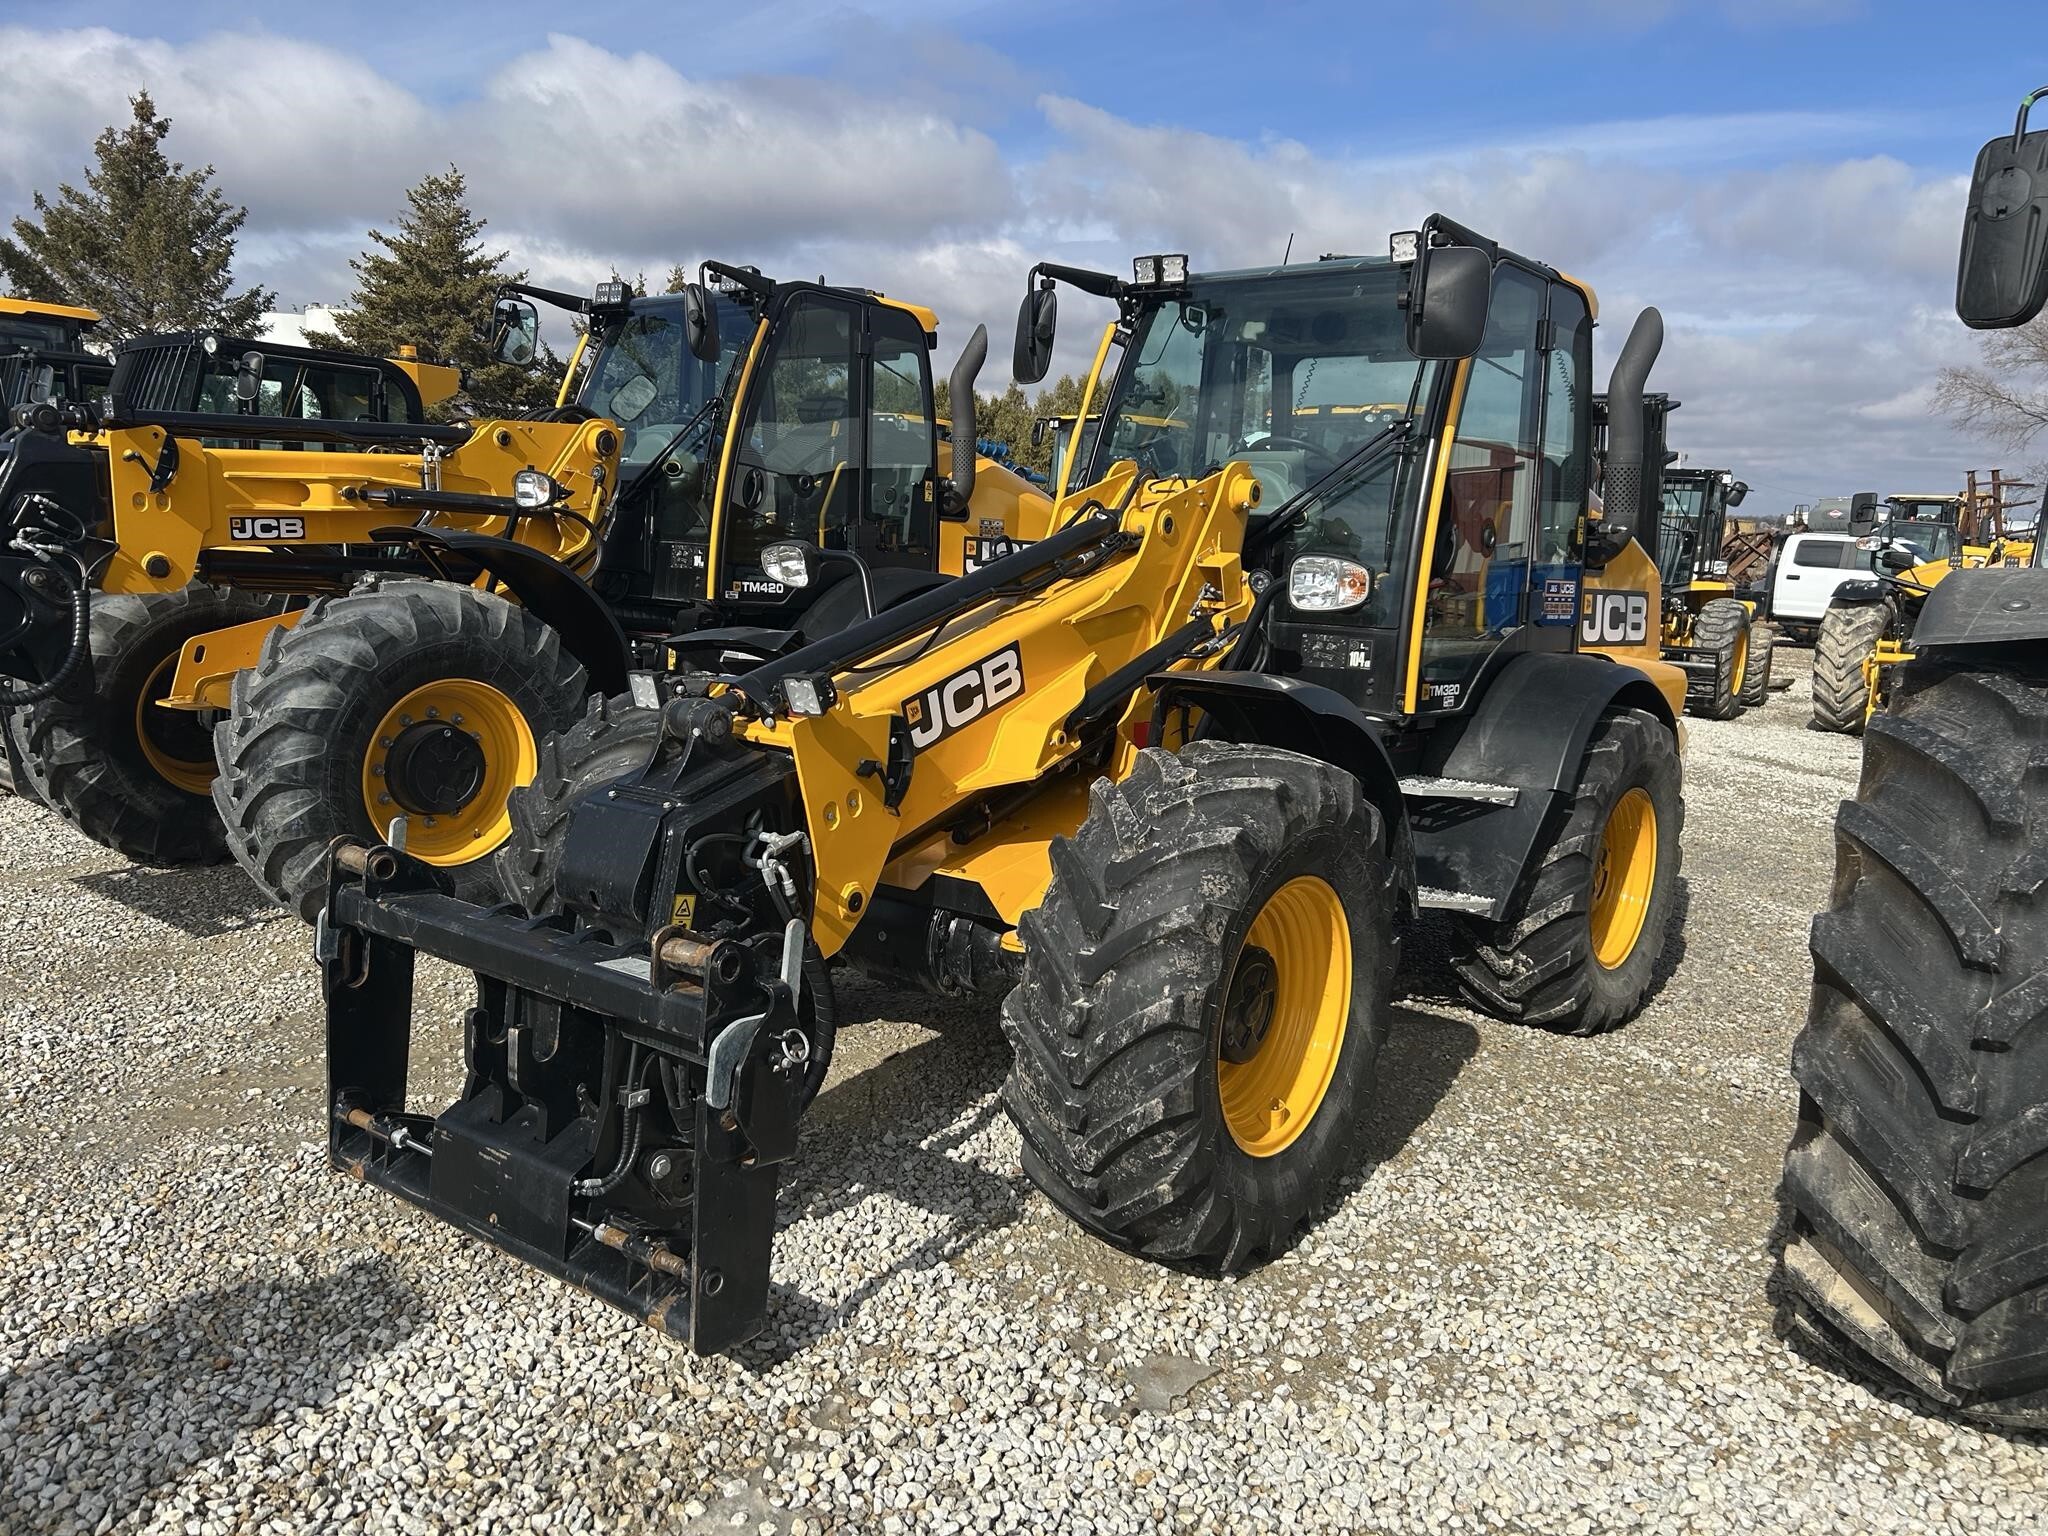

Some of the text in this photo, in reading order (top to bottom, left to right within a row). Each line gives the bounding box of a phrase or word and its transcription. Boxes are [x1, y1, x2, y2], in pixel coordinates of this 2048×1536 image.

[232, 518, 304, 539] JCB
[742, 581, 784, 594] TM420
[1582, 594, 1647, 642] JCB
[1349, 651, 1365, 668] 104
[910, 649, 1022, 749] JCB
[1430, 684, 1460, 697] TM320
